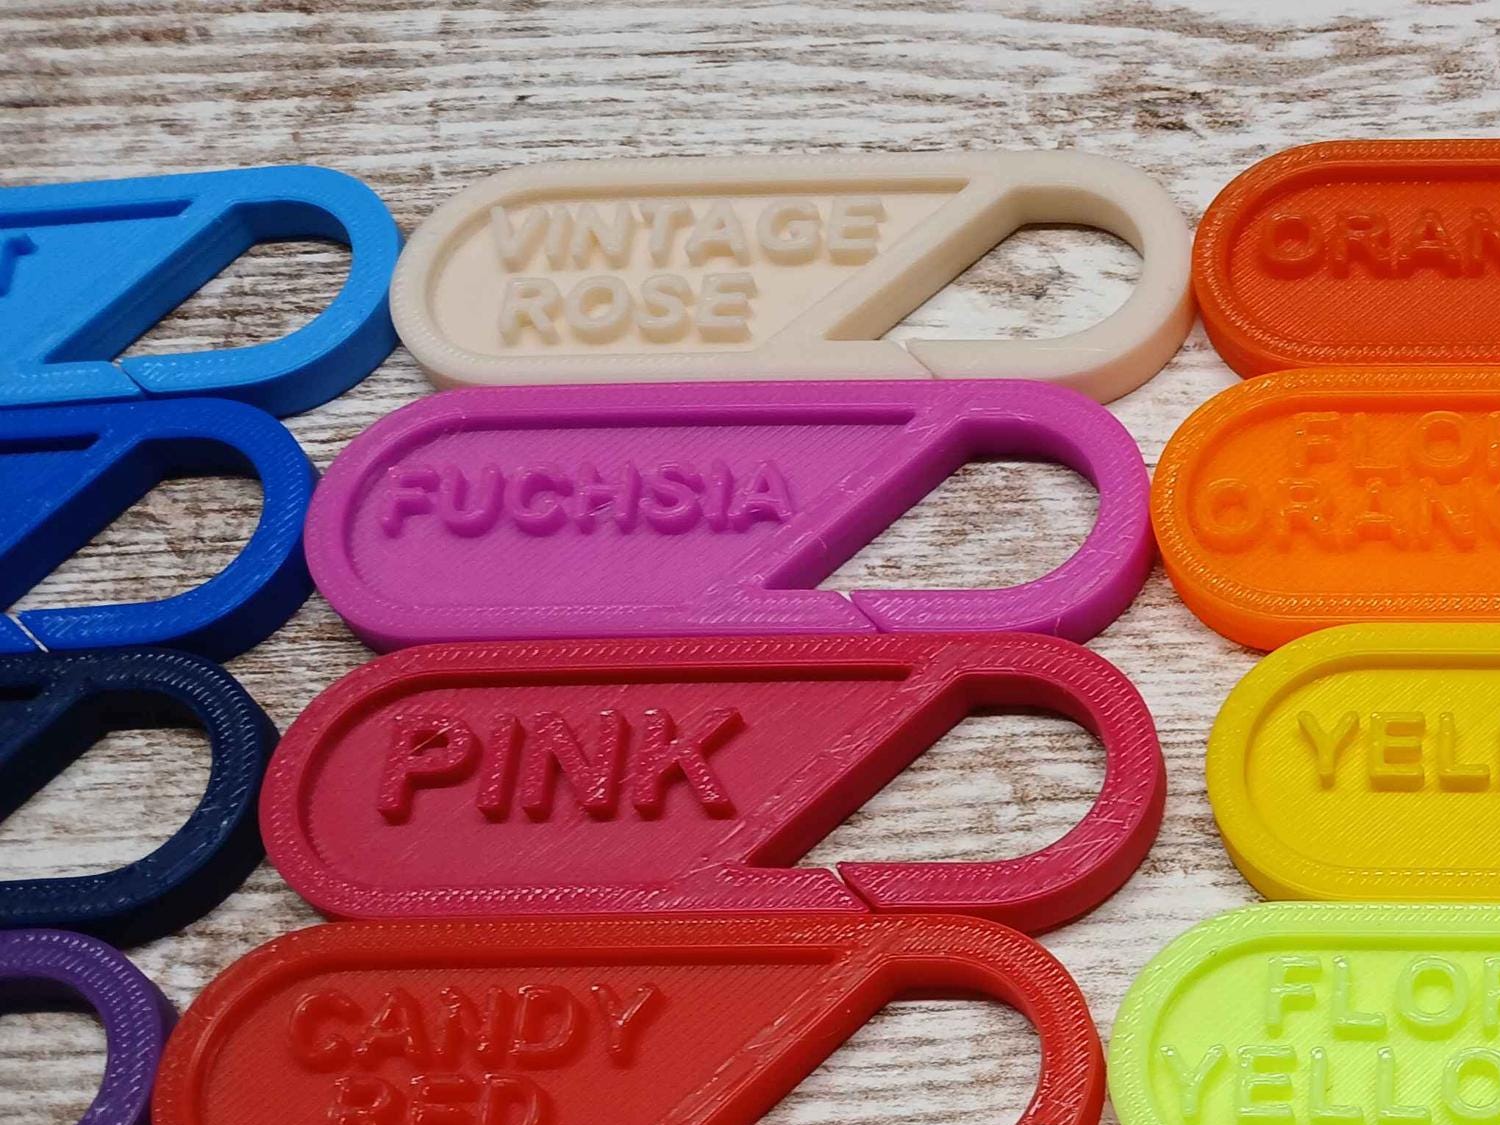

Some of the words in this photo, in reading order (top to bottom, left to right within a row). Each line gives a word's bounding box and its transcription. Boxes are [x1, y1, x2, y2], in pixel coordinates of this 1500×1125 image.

[490, 196, 887, 270] VINTAGE
[500, 271, 758, 345] ROSE
[379, 457, 796, 538] FUCHSIA
[376, 706, 748, 824] PINK
[288, 981, 666, 1071] CANDY
